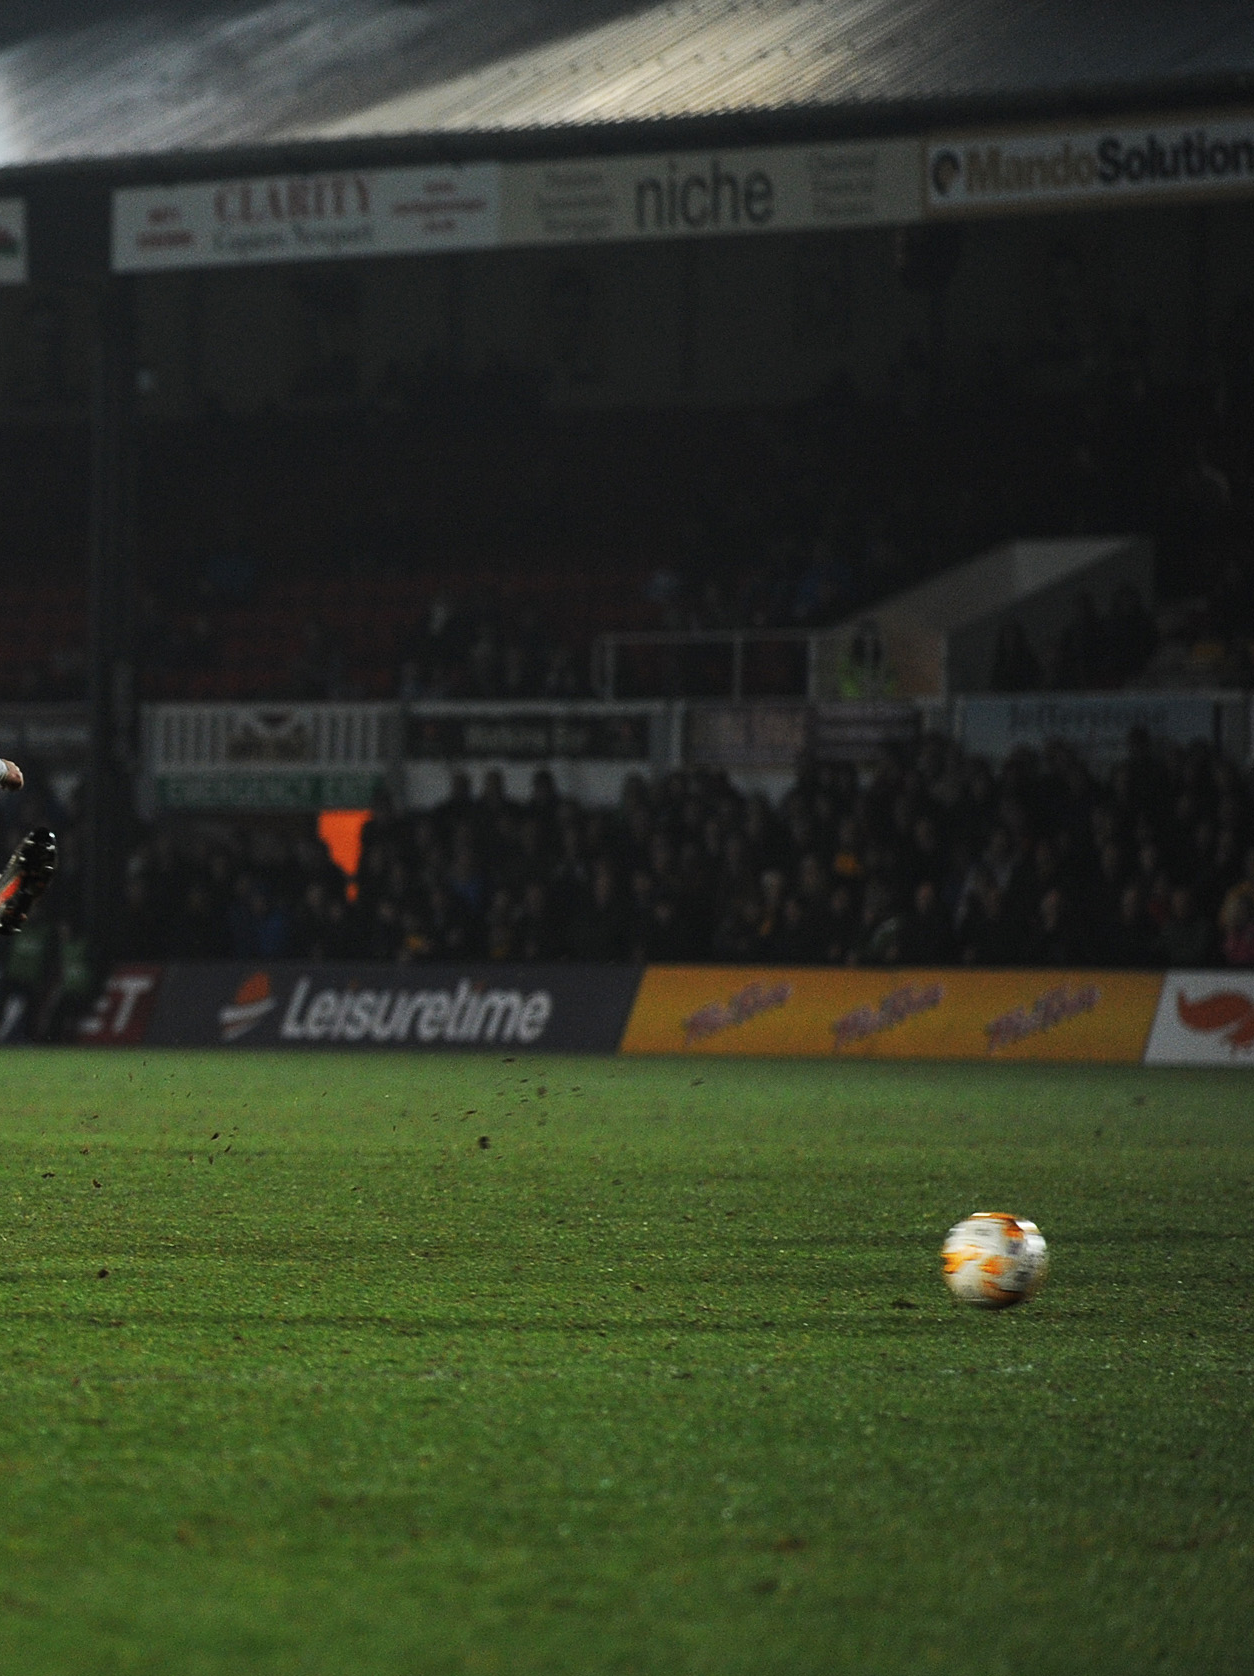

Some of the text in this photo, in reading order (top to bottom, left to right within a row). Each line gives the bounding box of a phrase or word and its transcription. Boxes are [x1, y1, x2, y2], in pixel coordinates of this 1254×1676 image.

[213, 176, 372, 222] CLARITY
[633, 158, 774, 228] niche
[280, 975, 554, 1044] Leisuretime
